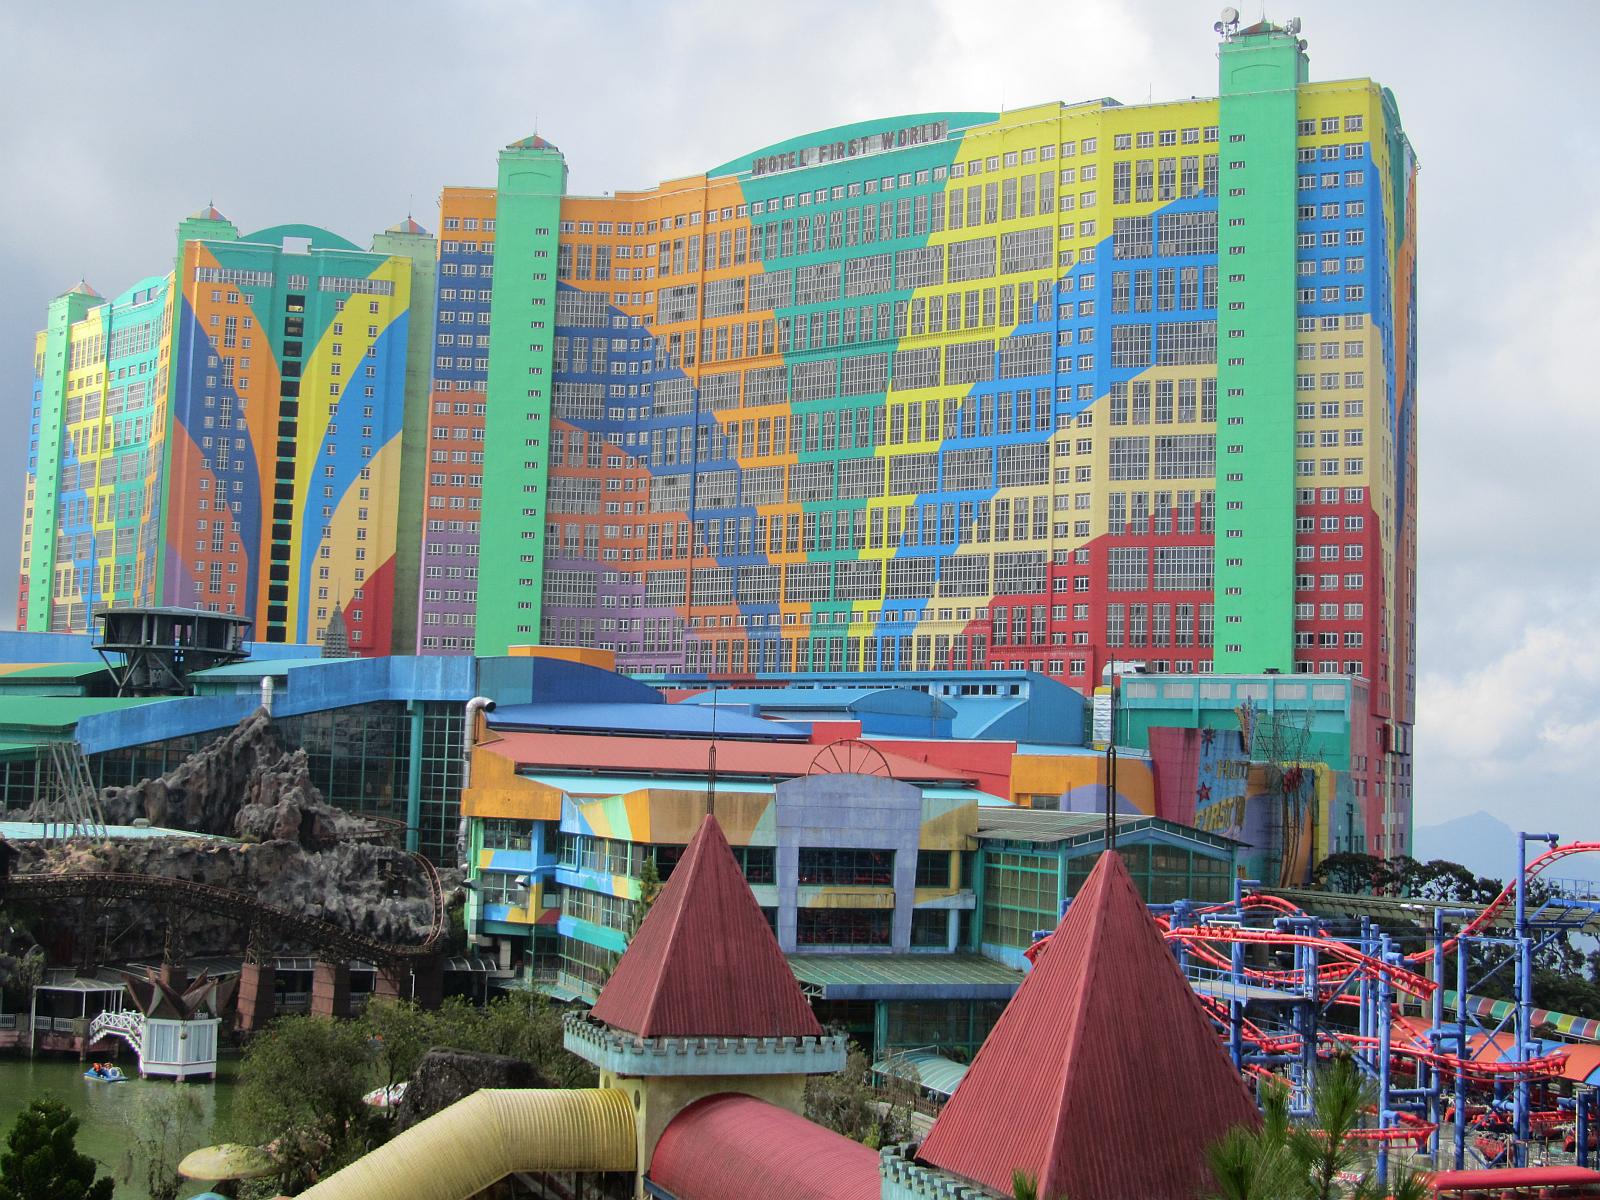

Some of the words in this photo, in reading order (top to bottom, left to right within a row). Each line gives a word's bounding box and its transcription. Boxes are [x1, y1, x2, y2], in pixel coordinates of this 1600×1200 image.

[755, 149, 808, 174] HOTEL
[819, 137, 869, 162] FIRST
[881, 121, 944, 150] WORLD
